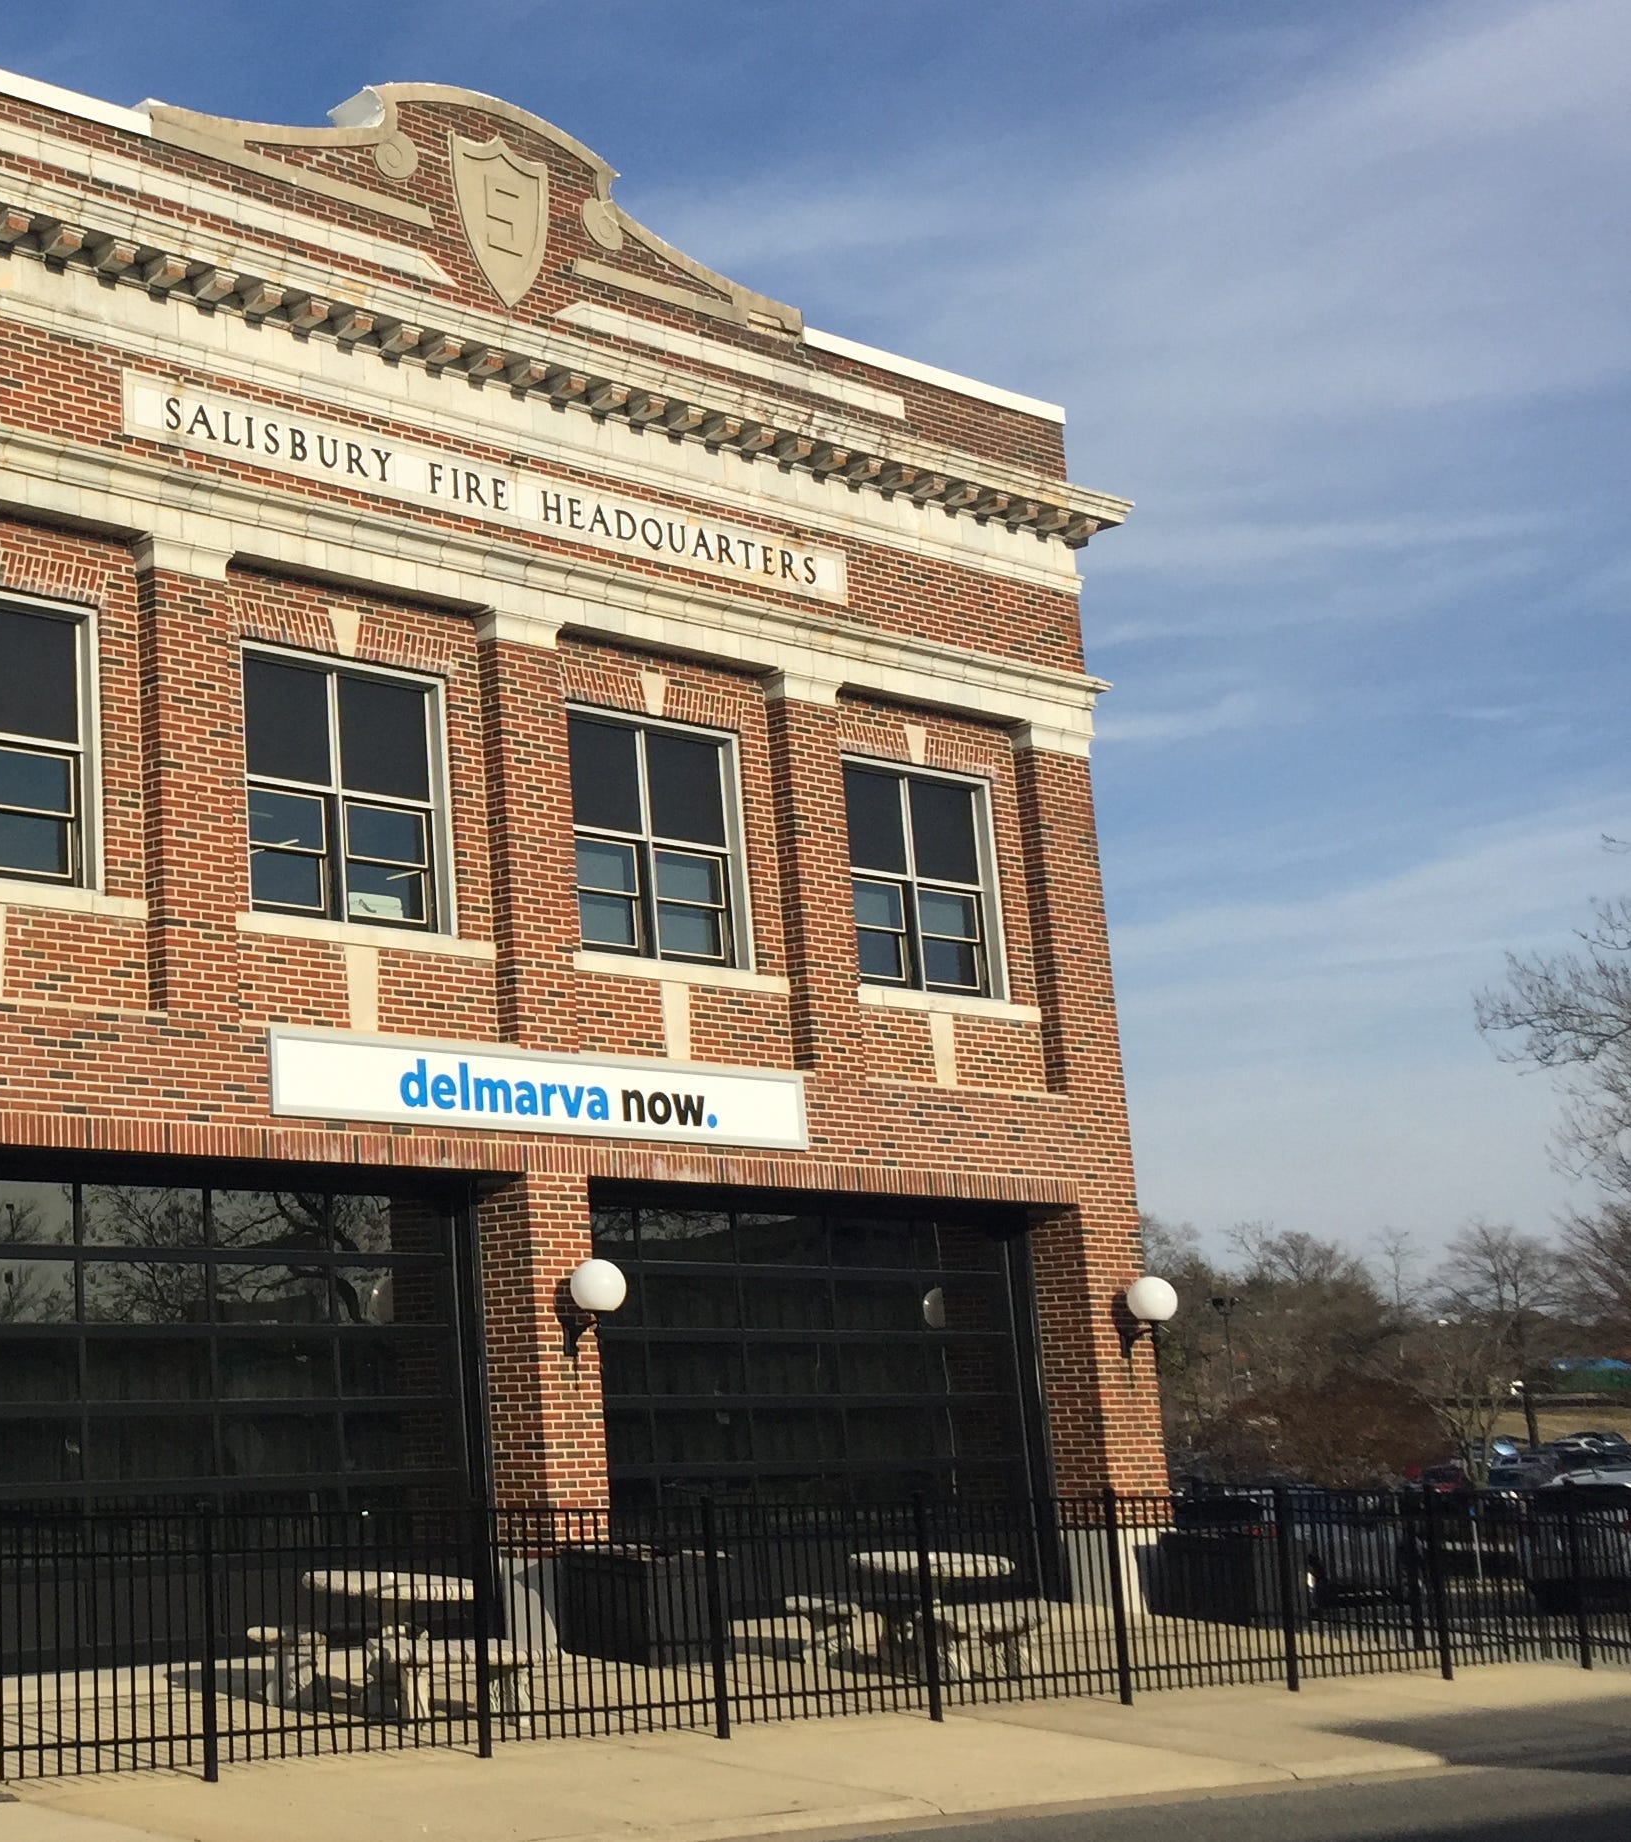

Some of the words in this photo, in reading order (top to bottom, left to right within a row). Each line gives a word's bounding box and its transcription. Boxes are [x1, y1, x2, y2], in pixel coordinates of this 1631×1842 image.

[165, 397, 393, 483] SALISBURY
[428, 462, 509, 512] FIRE
[541, 490, 818, 585] HEADQUARTERS
[399, 1058, 610, 1121] delmarva
[621, 1086, 718, 1129] now.
